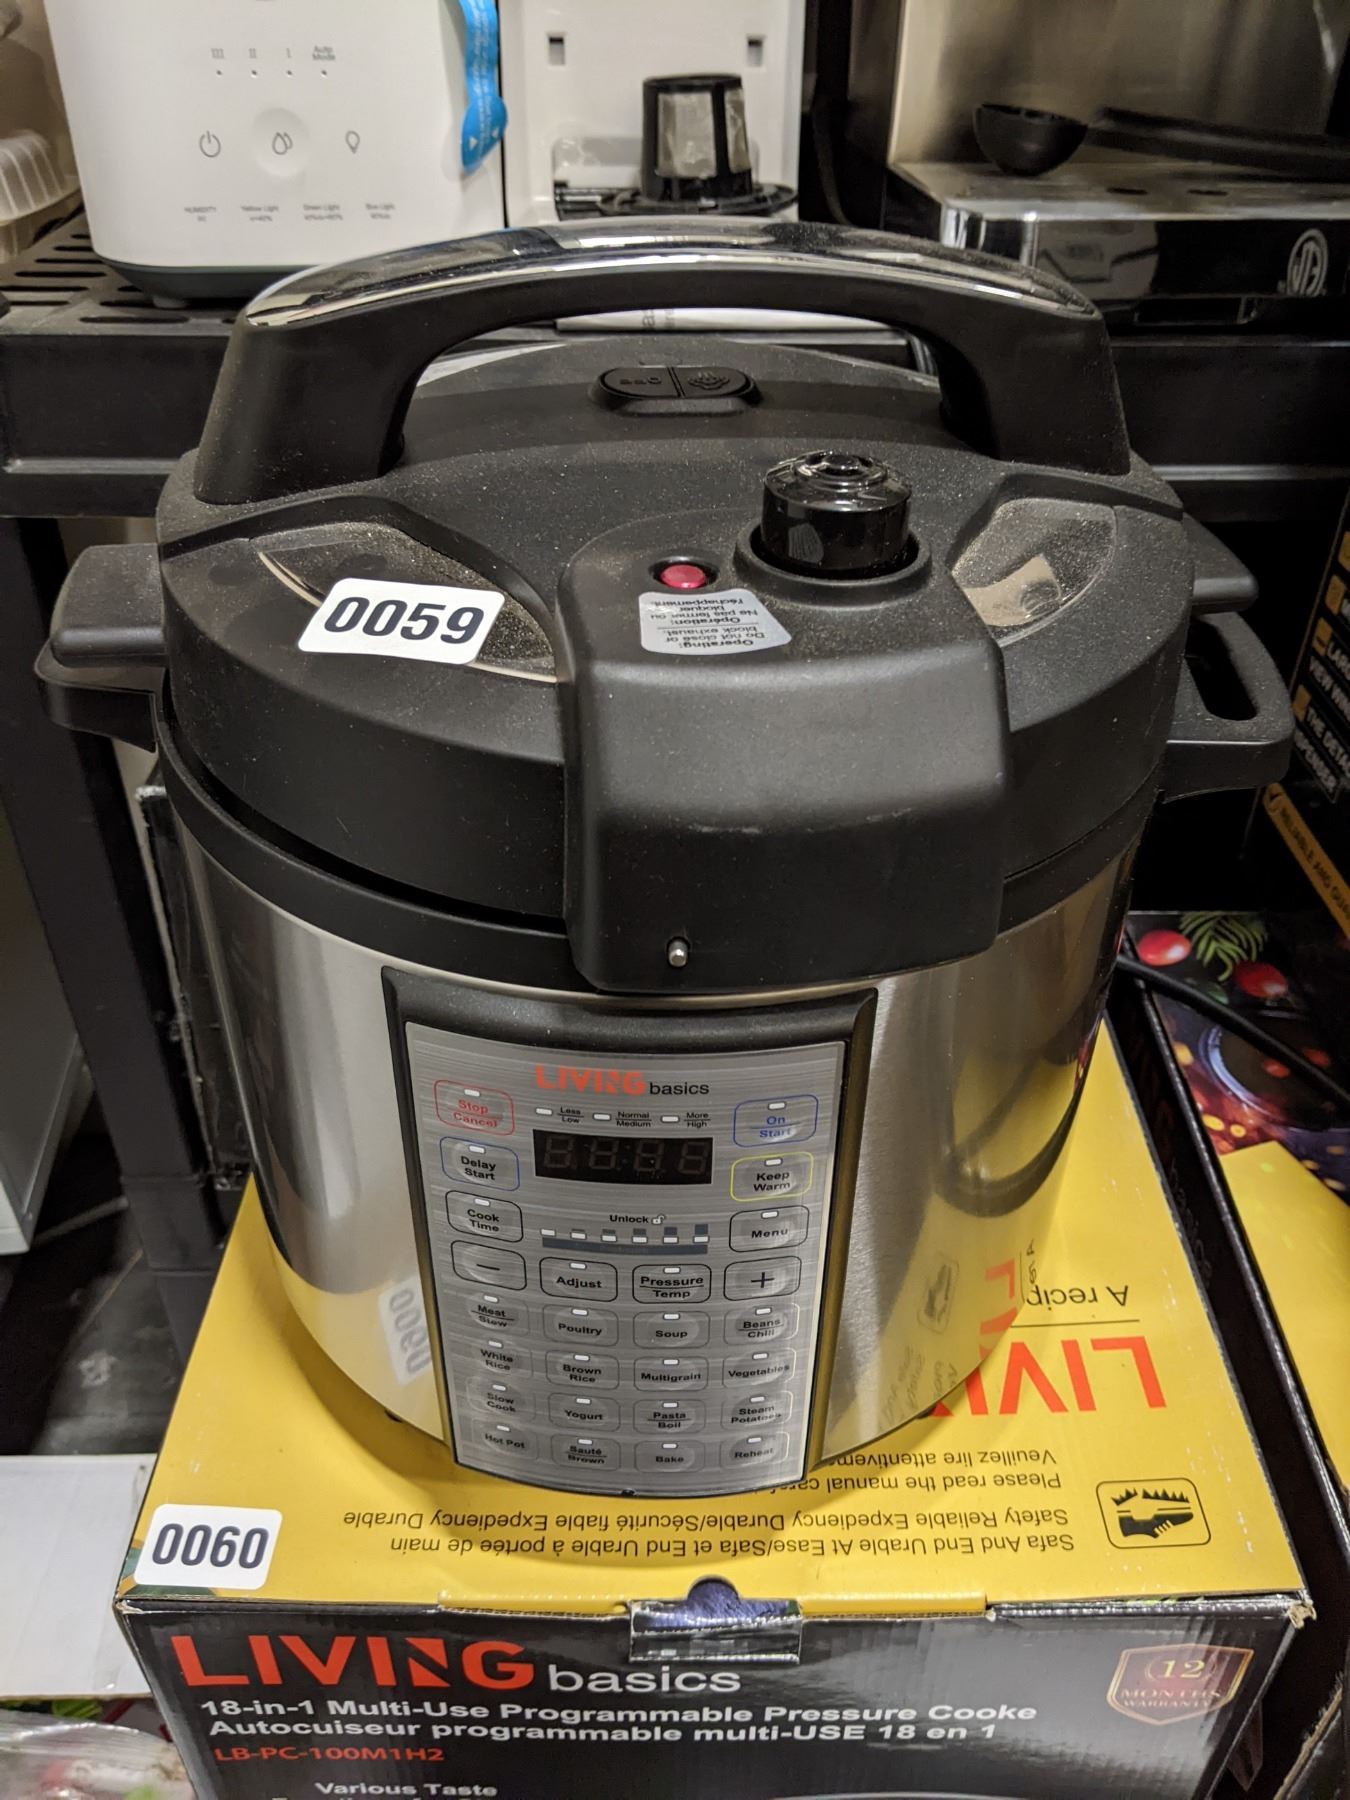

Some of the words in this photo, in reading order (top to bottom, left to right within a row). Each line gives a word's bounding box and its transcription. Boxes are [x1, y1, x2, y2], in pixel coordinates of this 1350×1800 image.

[324, 596, 485, 645] 0059
[722, 632, 742, 640] not
[535, 1064, 646, 1096] LIVING
[650, 1082, 710, 1095] basics
[458, 1100, 489, 1115] Stop
[560, 1106, 581, 1115] Less
[617, 1111, 650, 1119] Normal
[453, 1112, 498, 1128] Cancel
[561, 1116, 580, 1124] Low
[616, 1119, 651, 1127] Medium
[687, 1120, 708, 1128] High
[766, 1116, 786, 1125] On
[759, 1128, 791, 1138] Start
[461, 1155, 497, 1171] Delay
[464, 1167, 495, 1180] Start
[756, 1171, 790, 1181] Keep
[753, 1181, 791, 1192] Warm
[467, 1208, 500, 1222] Cook
[609, 1214, 649, 1224] Unlock
[469, 1219, 500, 1232] Time
[751, 1228, 788, 1239] Menu
[556, 1276, 602, 1289] Adjust
[640, 1276, 704, 1287] Pressure
[652, 1289, 691, 1299] Temp
[1026, 1284, 1098, 1311] recip
[1106, 1284, 1129, 1307] A
[477, 1304, 506, 1317] Meat
[558, 1323, 602, 1336] Poultry
[743, 1318, 781, 1329] Beans
[655, 1330, 688, 1339] Soup
[480, 1349, 514, 1363] White
[485, 1359, 511, 1371] Rice
[562, 1364, 602, 1376] Brown
[728, 1364, 790, 1378] Vegetables
[569, 1373, 596, 1383] Rice
[641, 1372, 701, 1383] Multigrain
[929, 1336, 1167, 1416] LIVI
[487, 1392, 514, 1405] Slow
[486, 1401, 516, 1413] Cook
[738, 1406, 775, 1416] Steam
[564, 1409, 603, 1421] Yogurt
[653, 1411, 686, 1420] Pasta
[657, 1421, 681, 1429] Boil
[485, 1433, 503, 1444] Hot
[506, 1438, 525, 1449] Pot
[569, 1445, 602, 1455] Sauté
[734, 1447, 775, 1460] Reheat
[980, 1449, 1057, 1466] Veuillez
[567, 1454, 605, 1464] Brown
[655, 1455, 684, 1464] Bake
[829, 1452, 937, 1467] attentivem
[943, 1450, 972, 1466] lire
[826, 1475, 898, 1491] manual
[906, 1474, 936, 1491] the
[943, 1473, 986, 1490] read
[1001, 1472, 1062, 1489] Please
[343, 1510, 423, 1529] Durable
[430, 1509, 548, 1531] Expediency
[555, 1513, 609, 1531] fiable
[616, 1513, 784, 1532] Durable/Sécurité
[792, 1511, 908, 1531] Expediency
[916, 1510, 997, 1528] Reliable
[1004, 1506, 1069, 1527] Safety
[152, 1523, 269, 1569] 0060
[391, 1538, 440, 1555] main
[448, 1538, 474, 1555] de
[480, 1537, 546, 1557] portée
[552, 1540, 565, 1556] à
[571, 1539, 638, 1557] Urable
[647, 1539, 686, 1557] End
[694, 1540, 712, 1556] et
[719, 1538, 825, 1556] Ease/Safa
[833, 1538, 853, 1556] At
[860, 1538, 927, 1556] Urable
[934, 1537, 973, 1555] End
[981, 1535, 1021, 1554] And
[1027, 1533, 1075, 1552] Safa
[170, 1635, 535, 1690] LIVING
[548, 1664, 741, 1694] basics
[1158, 1659, 1206, 1679] 12
[1123, 1699, 1212, 1708] WARRANTY
[200, 1700, 315, 1717] 18-in-1
[328, 1700, 490, 1719] Multi-Use
[501, 1703, 752, 1726] Programmable
[763, 1705, 917, 1722] Pressure
[927, 1704, 1037, 1721] Cooke
[209, 1719, 421, 1737] Autocuiseur
[432, 1723, 682, 1742] programmable
[693, 1724, 866, 1742] multi-USE
[877, 1724, 917, 1741] 18
[926, 1727, 966, 1740] en
[980, 1724, 998, 1739] 1
[215, 1746, 445, 1762] LB-PC-100M1H2
[314, 1782, 417, 1795] Various
[423, 1783, 499, 1797] Taste
